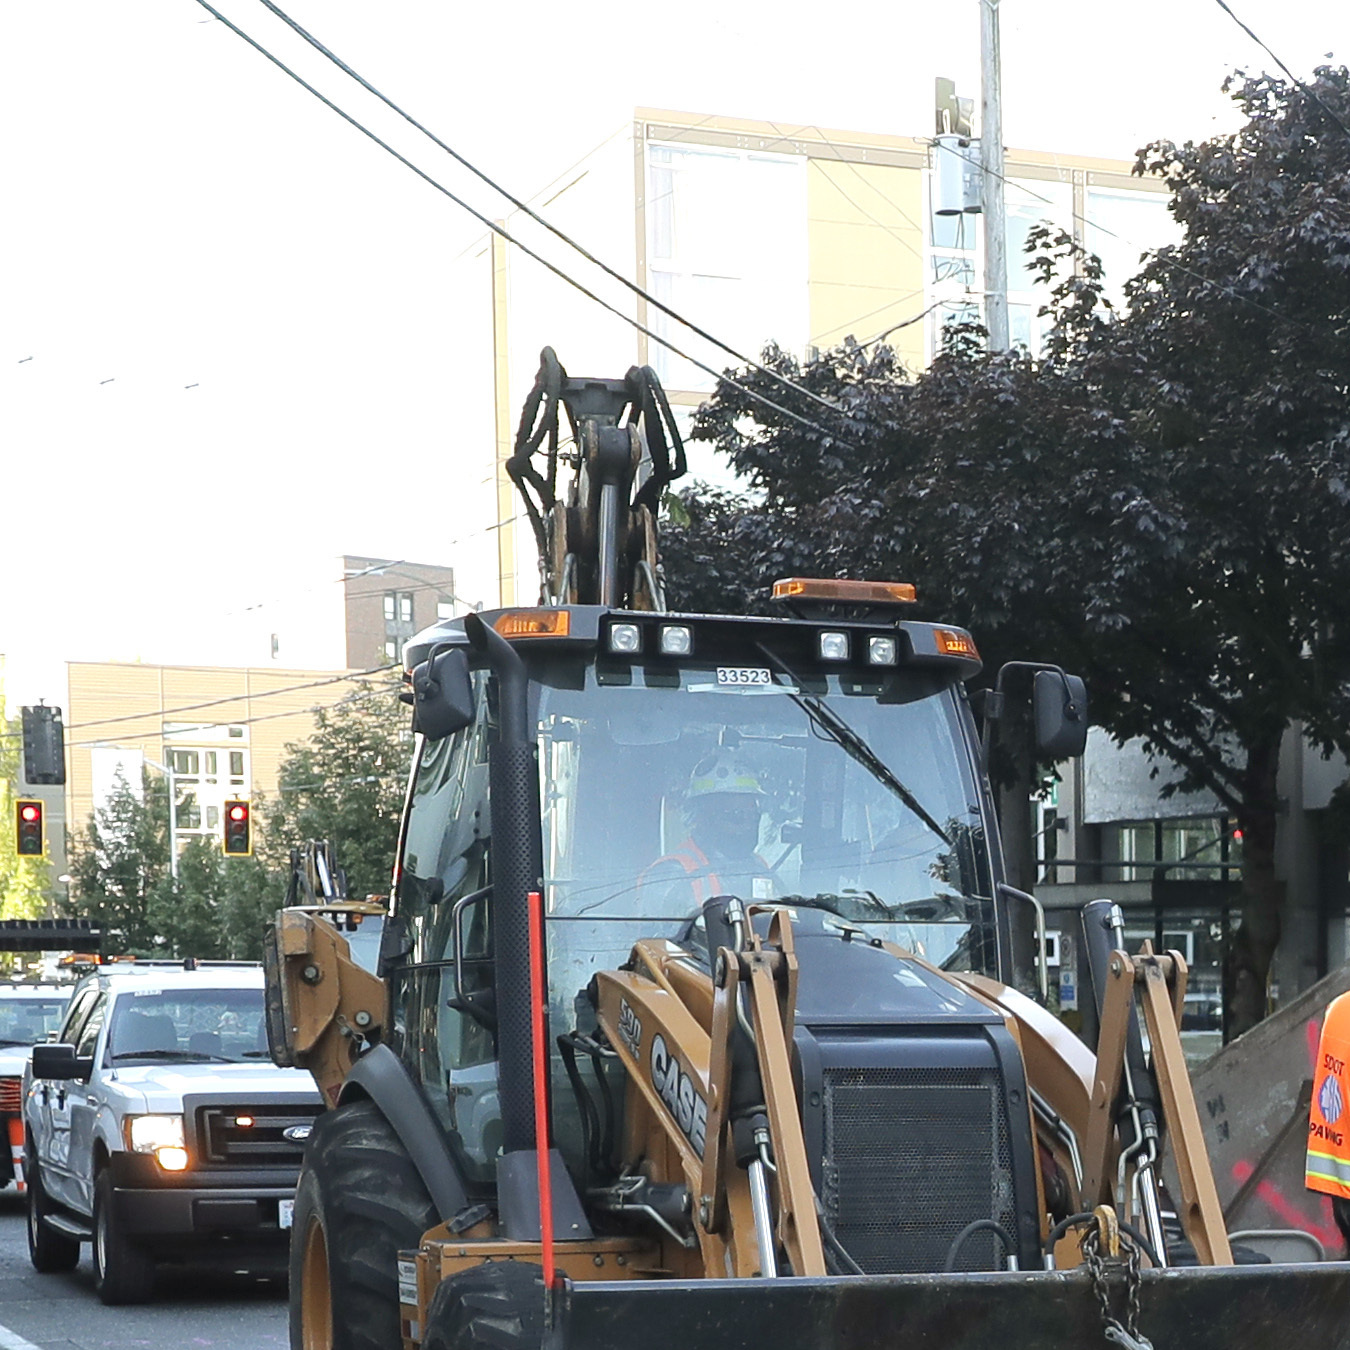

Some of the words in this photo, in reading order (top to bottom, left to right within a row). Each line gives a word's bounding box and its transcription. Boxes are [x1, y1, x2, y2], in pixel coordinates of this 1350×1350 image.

[718, 669, 770, 684] 33523
[619, 998, 642, 1047] 590
[1323, 1053, 1345, 1076] SDOT
[651, 1032, 708, 1160] CASE
